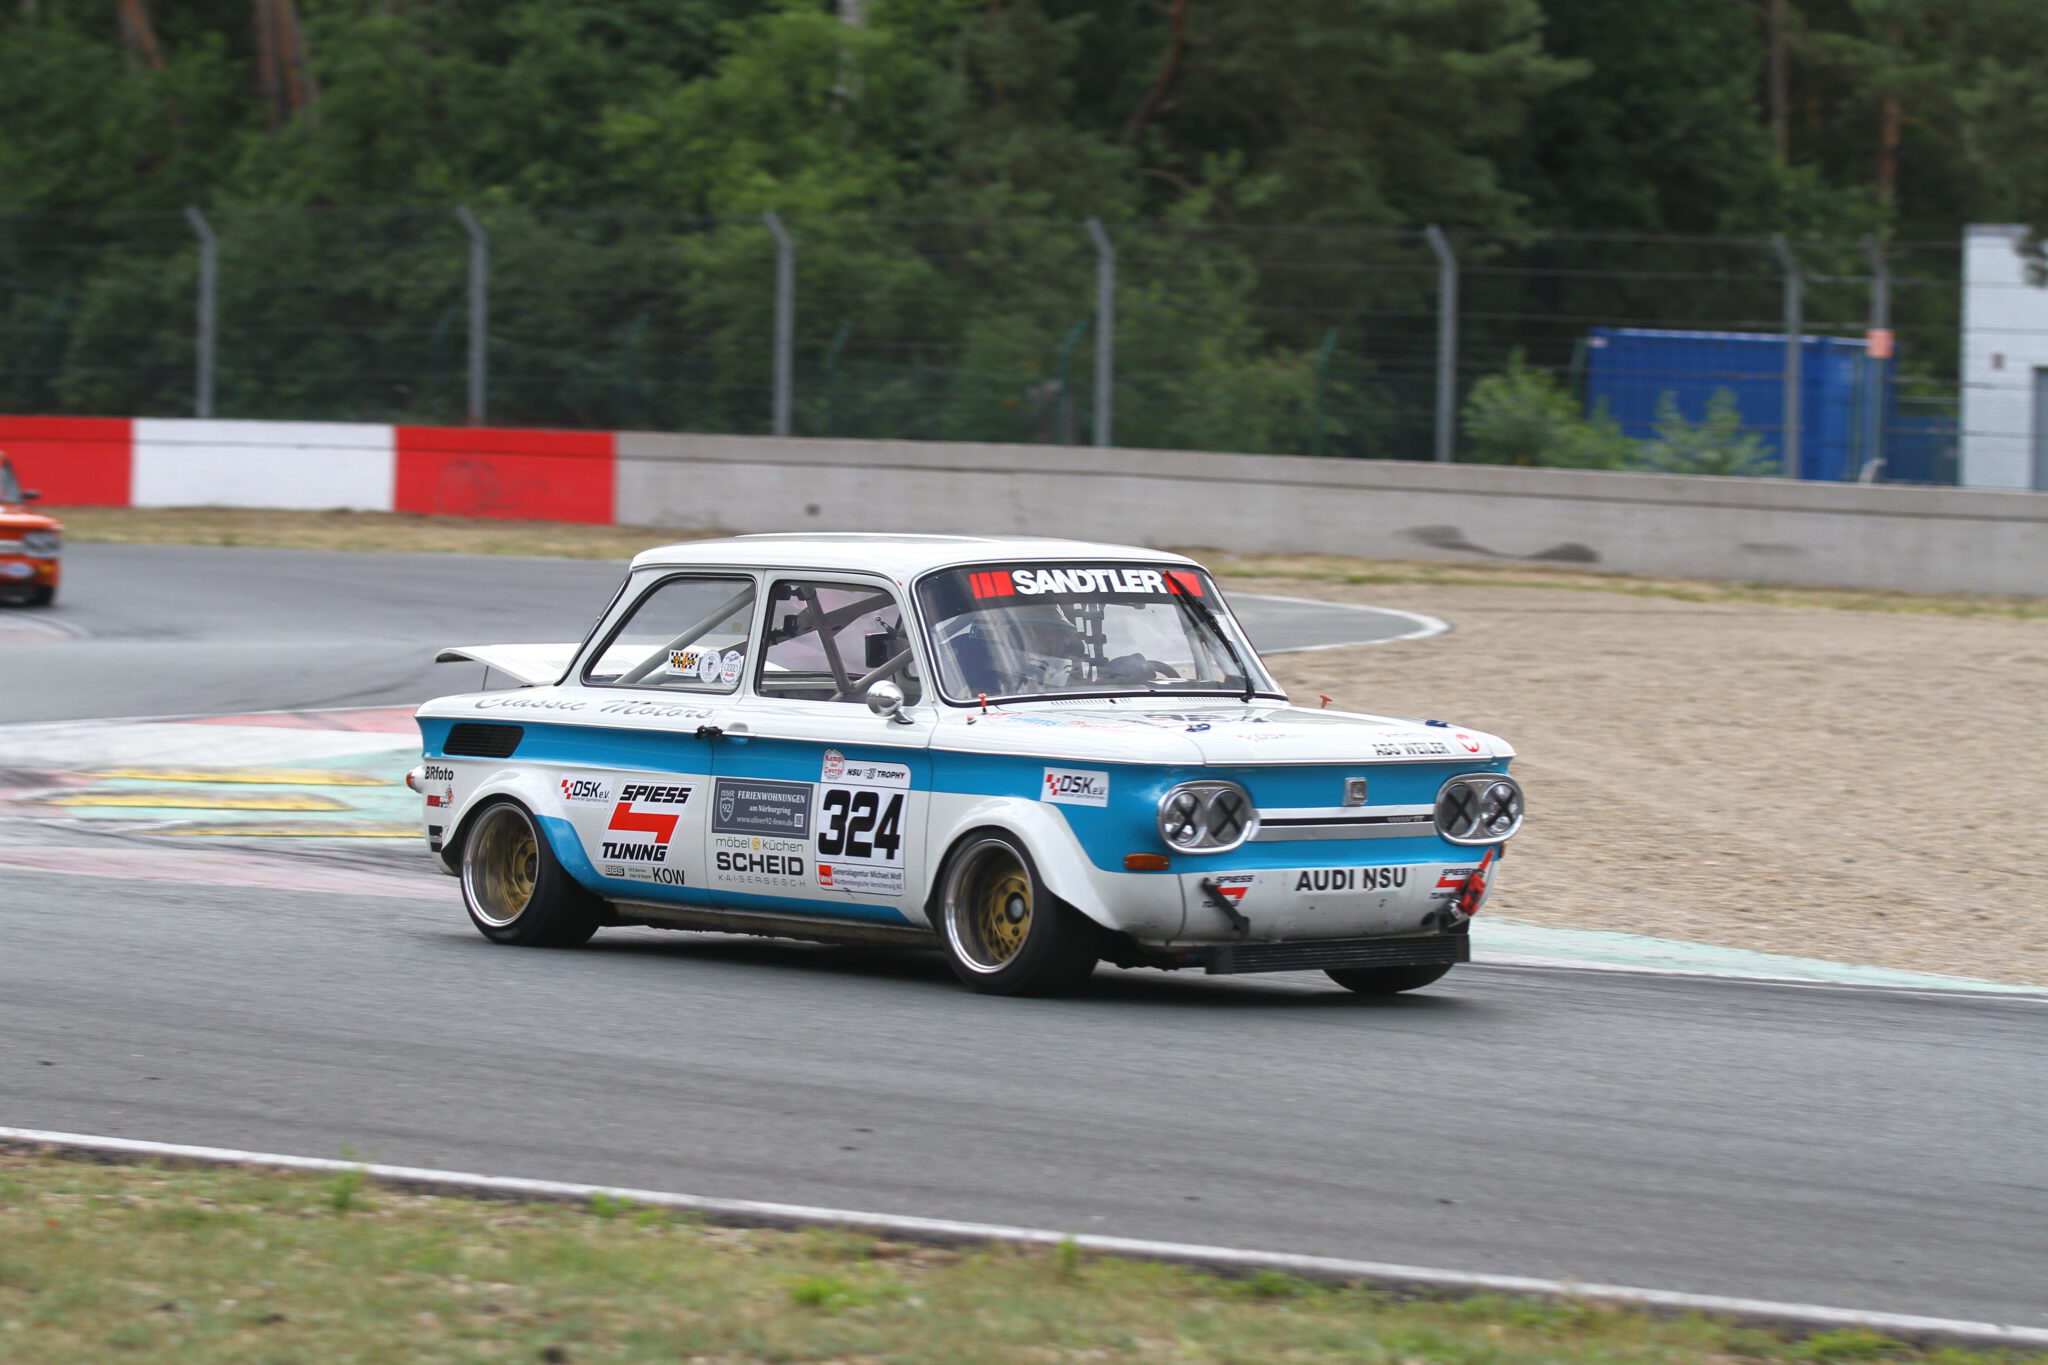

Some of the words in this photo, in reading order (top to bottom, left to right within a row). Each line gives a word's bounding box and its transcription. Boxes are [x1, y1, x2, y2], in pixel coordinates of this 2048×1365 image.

[1011, 569, 1168, 595] SANDTLER
[474, 696, 588, 710] Classic
[600, 700, 713, 719] Motors
[1406, 741, 1452, 755] WEILER
[425, 765, 454, 781] BRfoto
[847, 768, 862, 776] NSU
[877, 770, 906, 780] TROPHY
[572, 780, 602, 798] DSK
[1059, 774, 1095, 795] DSK
[619, 784, 693, 804] SPIESS
[737, 790, 806, 804] FERIENWOHNUNGEN
[722, 803, 732, 813] 92
[758, 804, 791, 816] Nürburgring
[818, 789, 904, 860] 324
[602, 841, 668, 862] TUNING
[716, 836, 750, 849] möbel
[762, 839, 804, 853] küchen
[606, 865, 625, 877] BBS
[716, 851, 804, 876] SCHEID
[652, 866, 686, 886] KOW
[1215, 874, 1255, 884] SPIESS
[1295, 868, 1356, 892] AUDI
[1362, 867, 1408, 890] NSU
